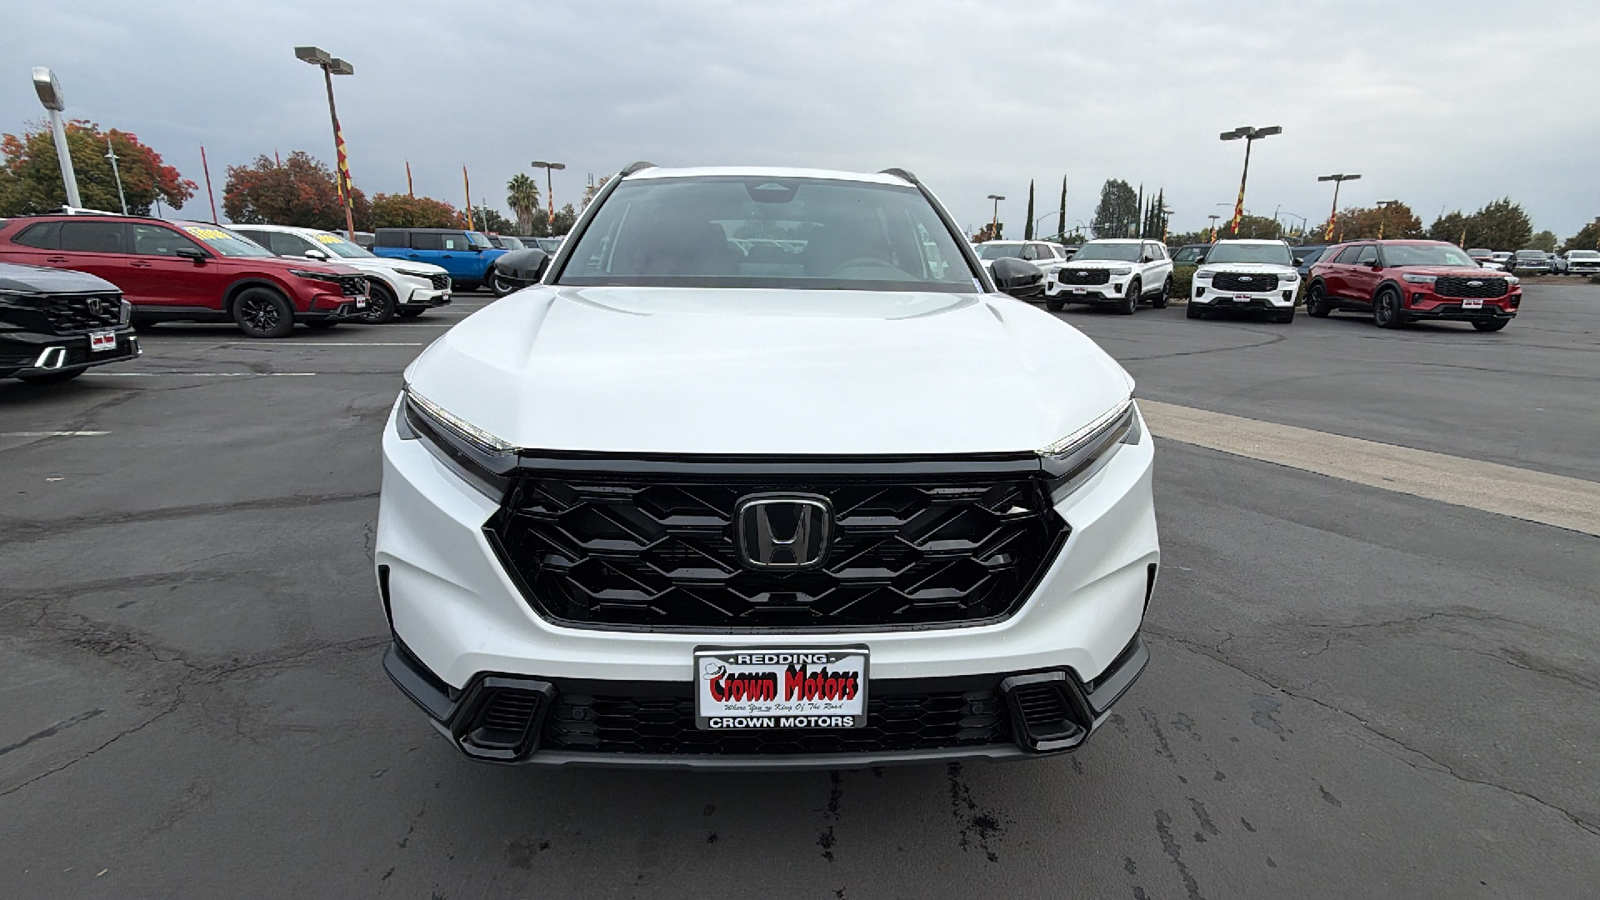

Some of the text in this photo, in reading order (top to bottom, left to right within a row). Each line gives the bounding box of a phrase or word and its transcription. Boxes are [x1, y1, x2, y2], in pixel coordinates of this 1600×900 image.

[737, 654, 827, 664] REDDING
[709, 664, 859, 702] Crown Motors
[774, 703, 793, 712] King
[795, 703, 805, 712] Of
[709, 716, 854, 728] CROWN MOTORS
